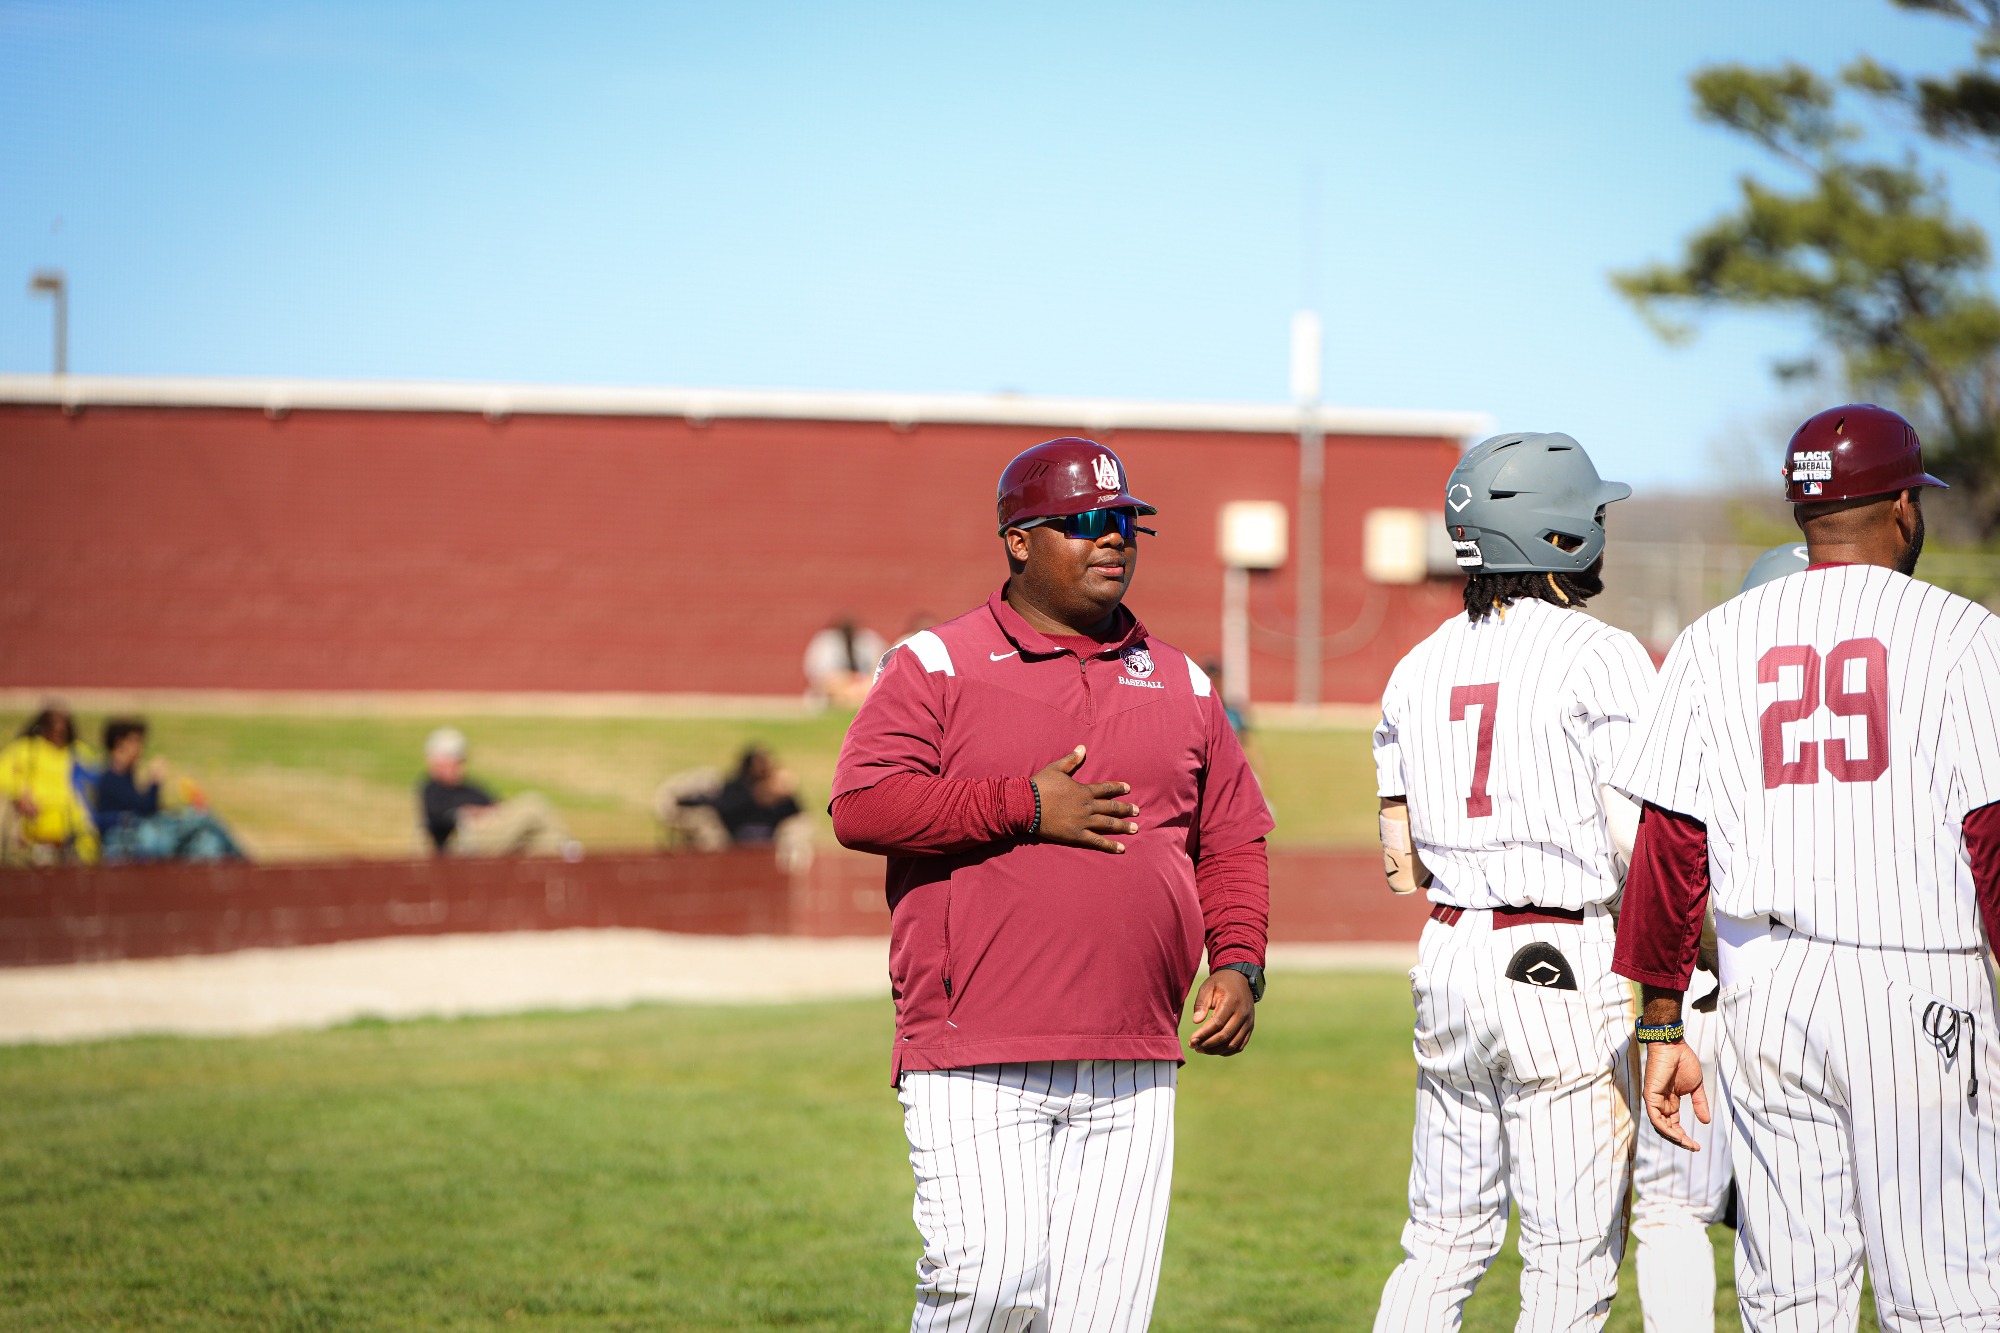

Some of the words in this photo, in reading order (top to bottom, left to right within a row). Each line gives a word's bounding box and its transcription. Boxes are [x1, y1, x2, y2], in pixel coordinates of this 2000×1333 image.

[1117, 675, 1165, 689] BASEBALL
[1449, 682, 1499, 818] 7
[1757, 637, 1889, 789] 29
